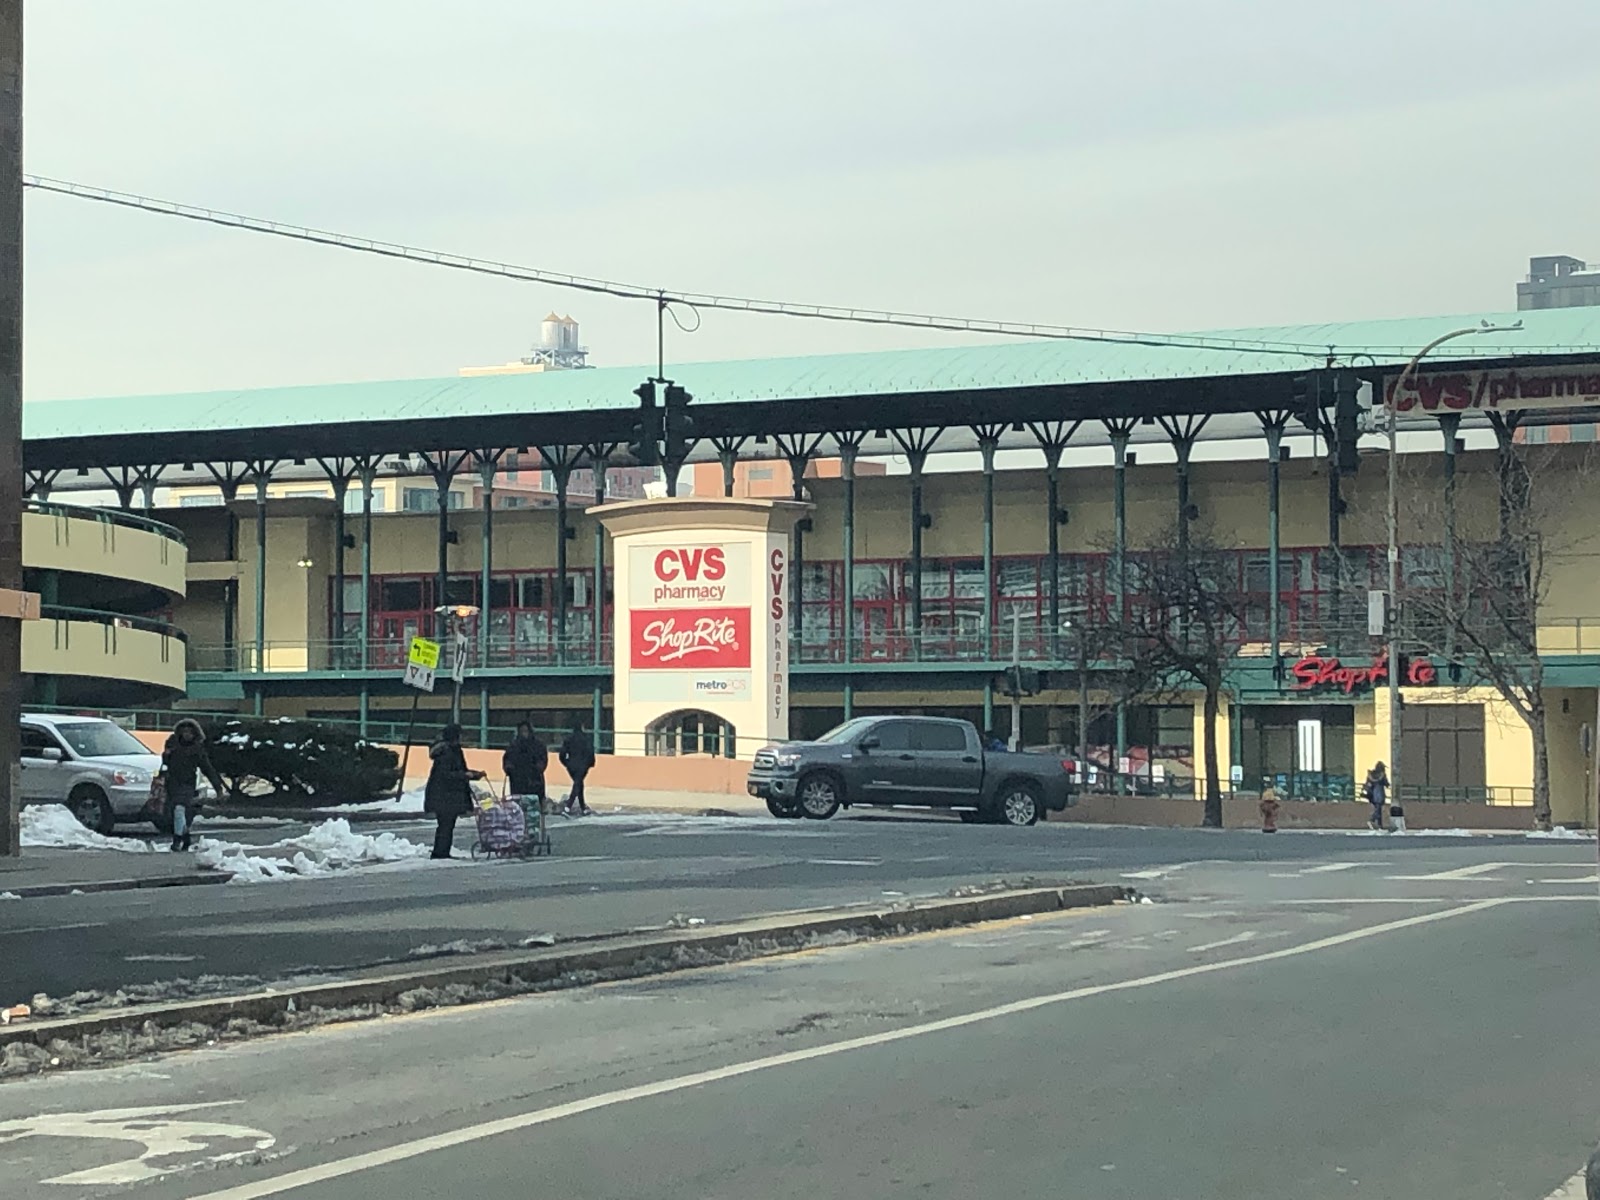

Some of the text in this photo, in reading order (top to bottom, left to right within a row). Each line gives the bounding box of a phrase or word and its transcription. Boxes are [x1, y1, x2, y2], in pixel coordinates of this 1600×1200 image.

[654, 547, 726, 582] CVS
[770, 549, 784, 620] CVS
[654, 583, 726, 603] pharmacy
[640, 617, 736, 661] ShopRite
[774, 622, 783, 719] pharmacy
